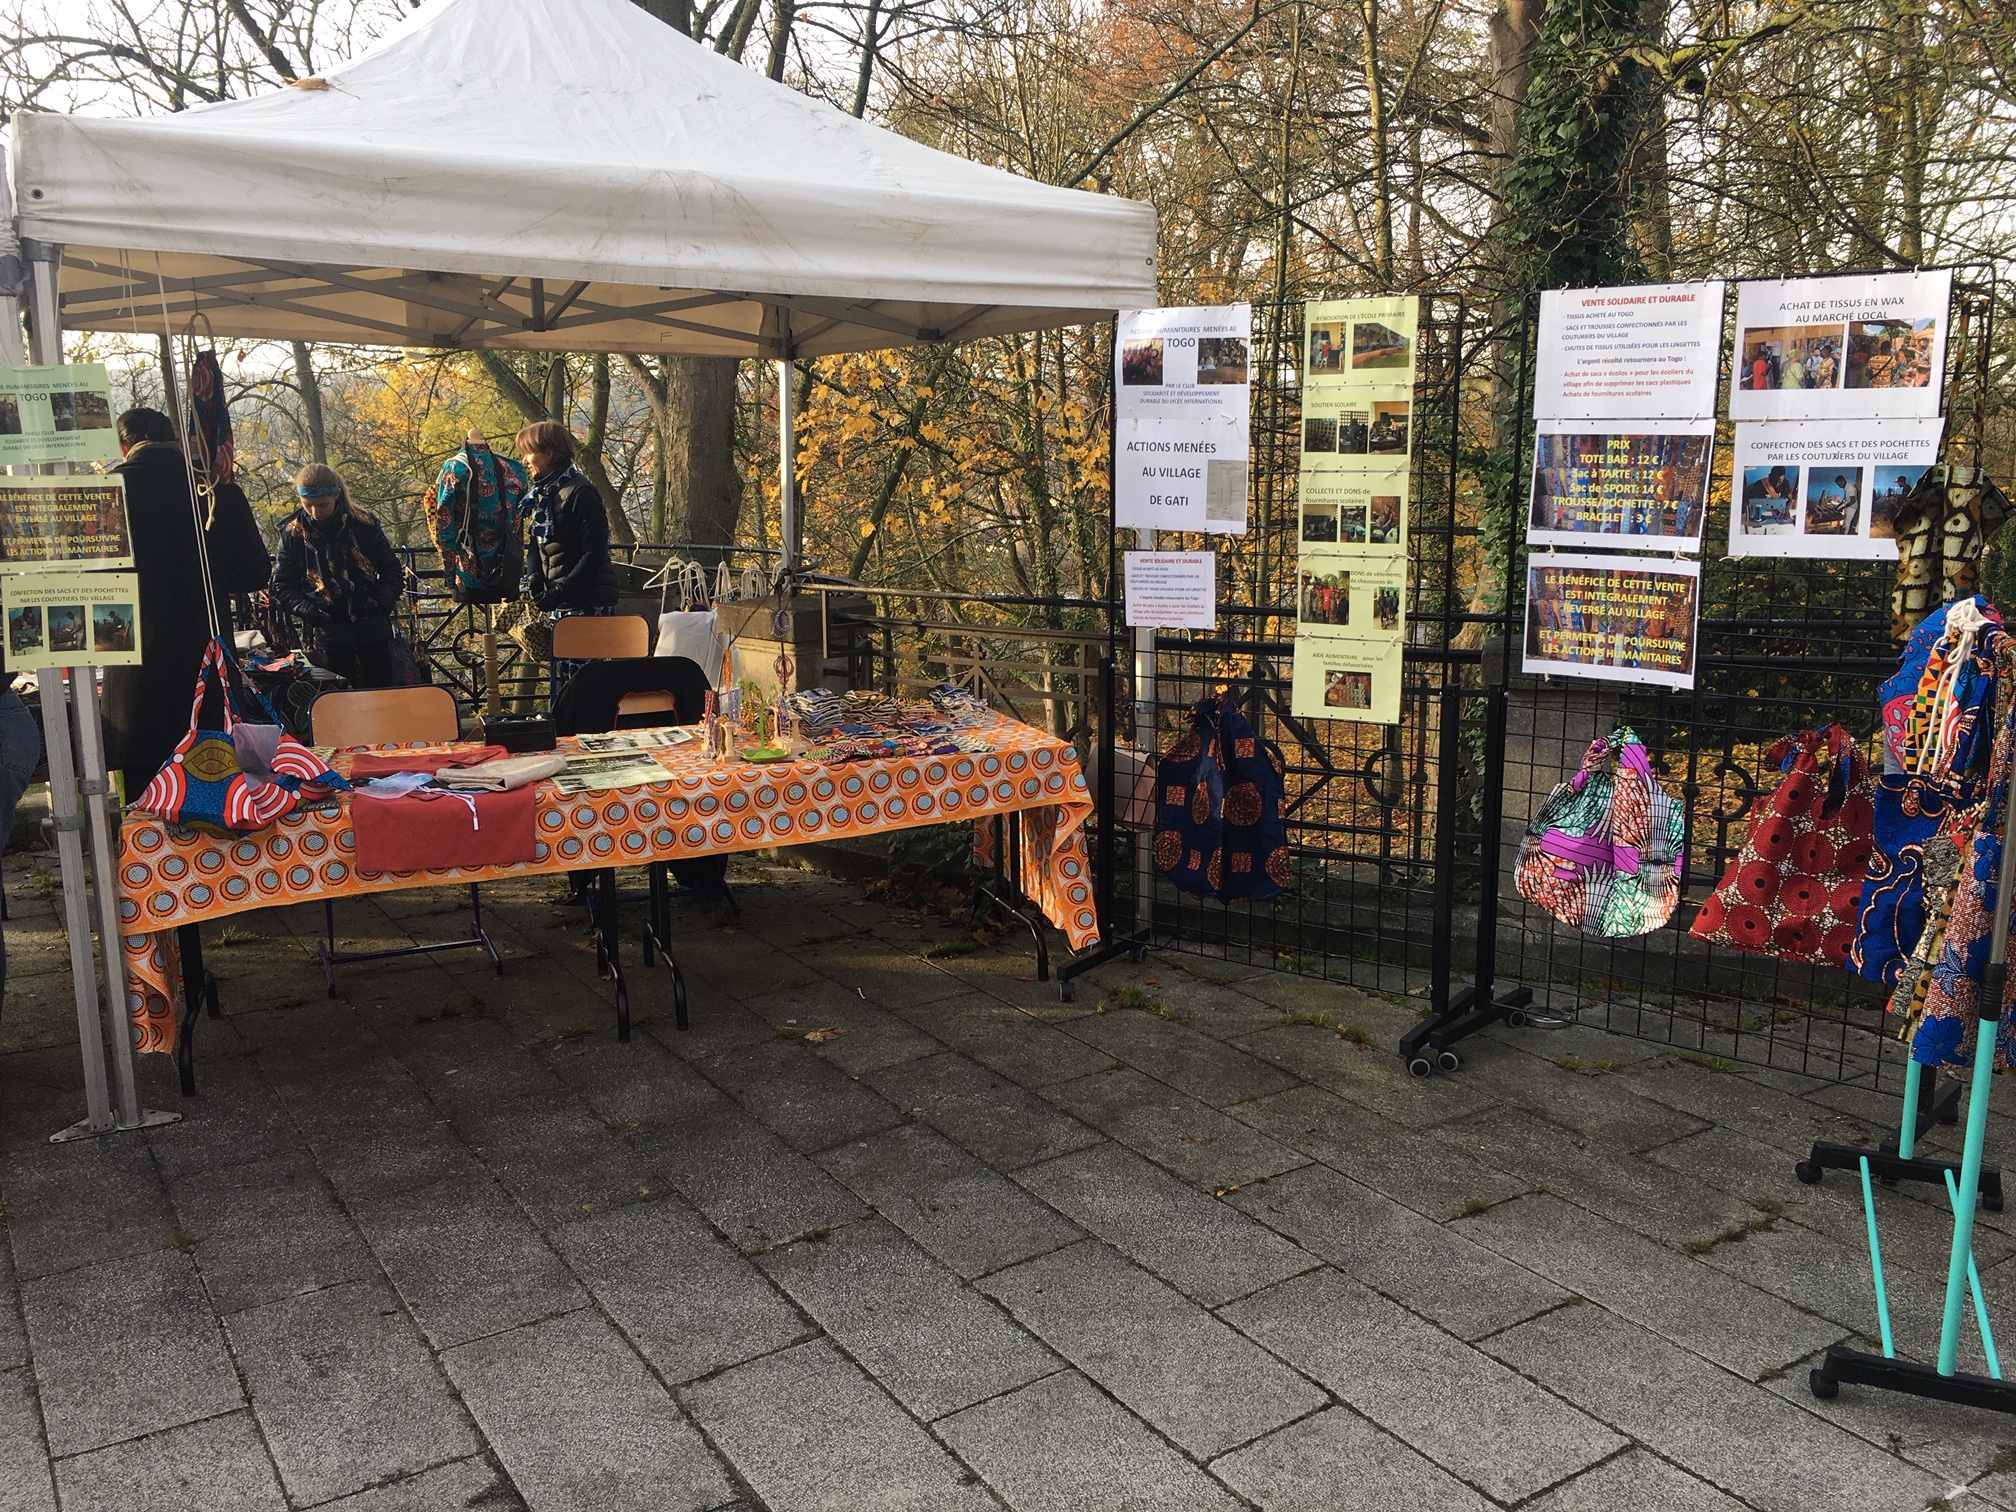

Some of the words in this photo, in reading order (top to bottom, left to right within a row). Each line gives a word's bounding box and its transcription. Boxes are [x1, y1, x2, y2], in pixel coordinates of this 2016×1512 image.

[1582, 298, 1605, 307] VENTE
[1607, 296, 1646, 305] SOLIDAIRE
[1659, 294, 1695, 302] DURABLE
[1779, 302, 1811, 310] ACHAT
[1830, 299, 1862, 308] TISSUS
[1881, 297, 1905, 305] WAX
[1813, 311, 1854, 322] MARCHÉ
[1167, 338, 1195, 348] TOGO
[19, 393, 47, 401] TOGO
[1127, 442, 1170, 452] ACTIONS
[1174, 441, 1216, 453] MENÉES
[1607, 440, 1630, 449] PRIX
[1580, 455, 1604, 464] TOTE
[1607, 455, 1628, 464] BAG
[1637, 456, 1649, 464] 12
[1652, 456, 1658, 464] €
[1142, 467, 1156, 477] AU
[1159, 468, 1201, 478] VILLAGE
[1571, 470, 1589, 478] Sac
[1591, 469, 1597, 478] à
[1600, 469, 1630, 478] TARTE
[1642, 470, 1654, 479] 12
[1657, 471, 1663, 479] €
[1570, 483, 1586, 492] Sac
[1588, 484, 1600, 493] de
[1604, 484, 1639, 493] SPORT:
[1642, 485, 1654, 494] 14
[1657, 485, 1663, 494] €
[1150, 495, 1162, 505] DE
[1165, 496, 1188, 506] GATI
[1553, 496, 1654, 509] TROUSSE/POCHETTE
[1671, 501, 1678, 509] €
[16, 514, 48, 523] REVERSÉ
[1576, 512, 1625, 522] BRACELET
[1637, 514, 1644, 523] 3
[1645, 515, 1652, 523] €
[56, 545, 119, 554] HUMANITAIRES
[1545, 576, 1556, 584] LE
[1559, 574, 1604, 587] BÉNÉFICE
[1607, 578, 1621, 587] DE
[1623, 580, 1652, 589] CETTE
[1654, 582, 1685, 592] VENTE
[1565, 590, 1582, 599] EST
[1585, 592, 1668, 605] INTEGRALEMENT
[1564, 604, 1605, 614] REVERSÉ
[1608, 607, 1622, 616] AU
[1626, 609, 1665, 620] VILLAGE
[1540, 630, 1551, 639] ET
[1608, 634, 1620, 644] DE
[1624, 636, 1686, 652] POURSUIVRE
[1543, 644, 1559, 653] LES
[1561, 646, 1604, 657] ACTIONS
[1607, 650, 1682, 665] HUMANITAIRES
